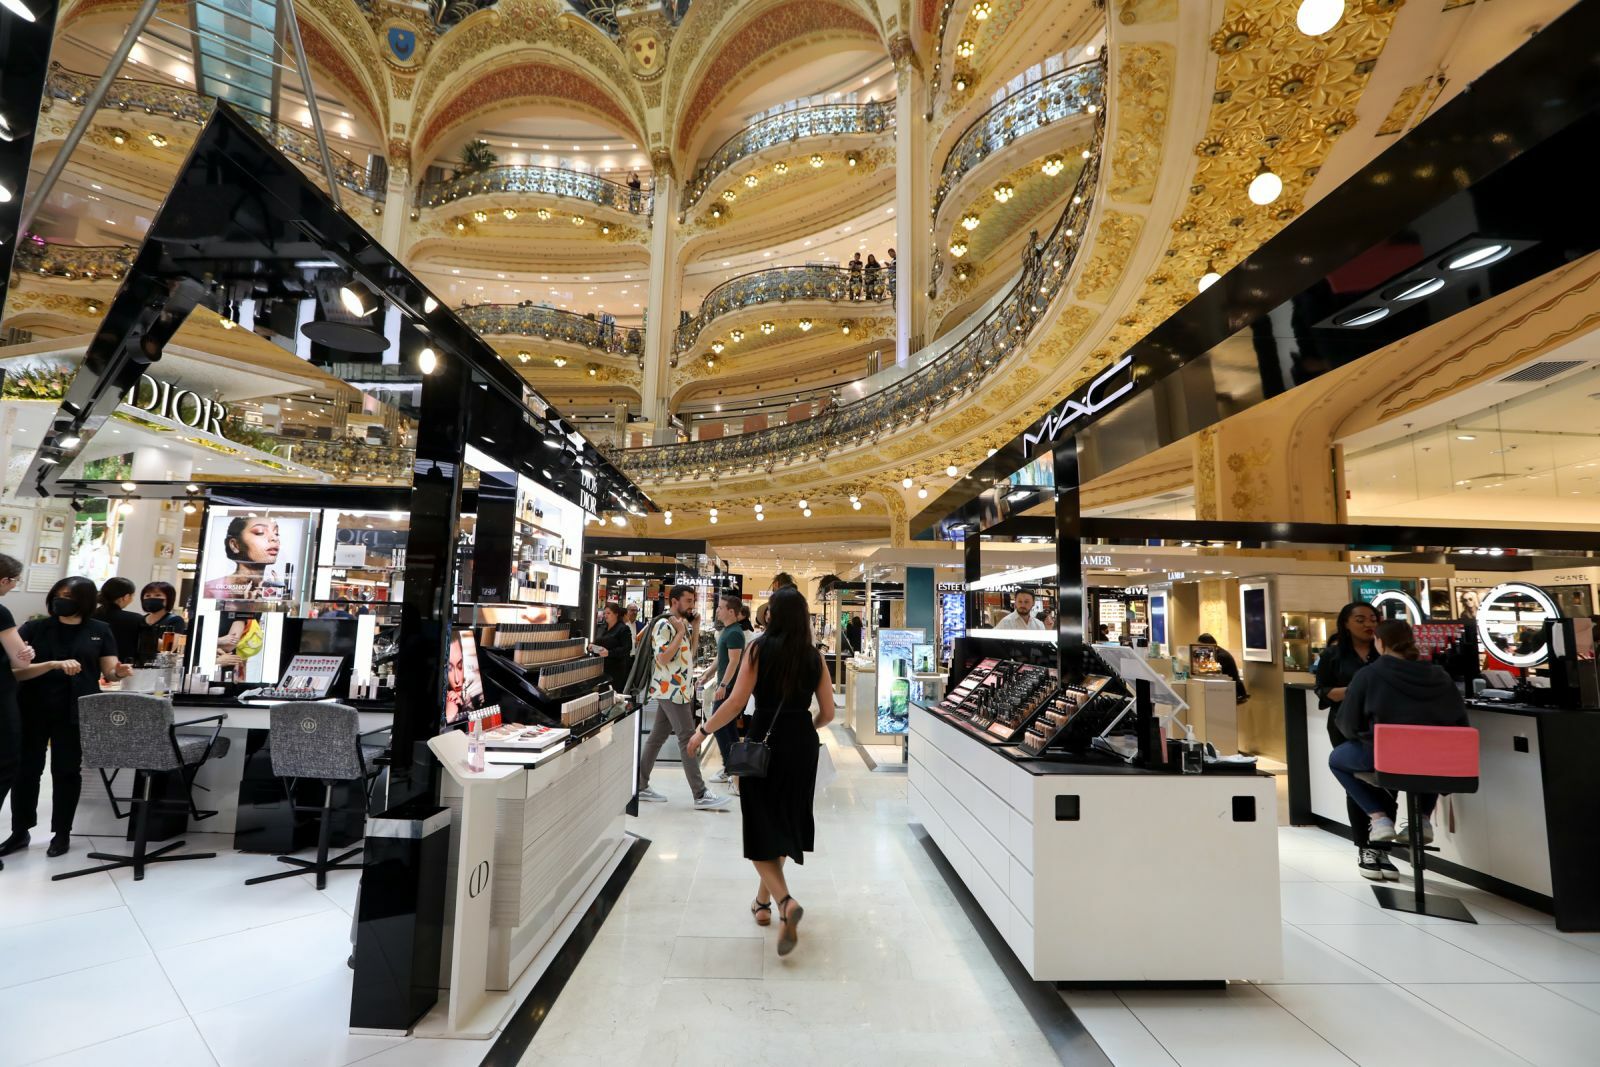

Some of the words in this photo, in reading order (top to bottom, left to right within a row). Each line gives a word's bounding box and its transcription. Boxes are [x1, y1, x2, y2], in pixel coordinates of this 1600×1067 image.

[128, 374, 226, 439] DIOR
[580, 489, 597, 515] DIOR
[677, 578, 714, 586] CHANEL
